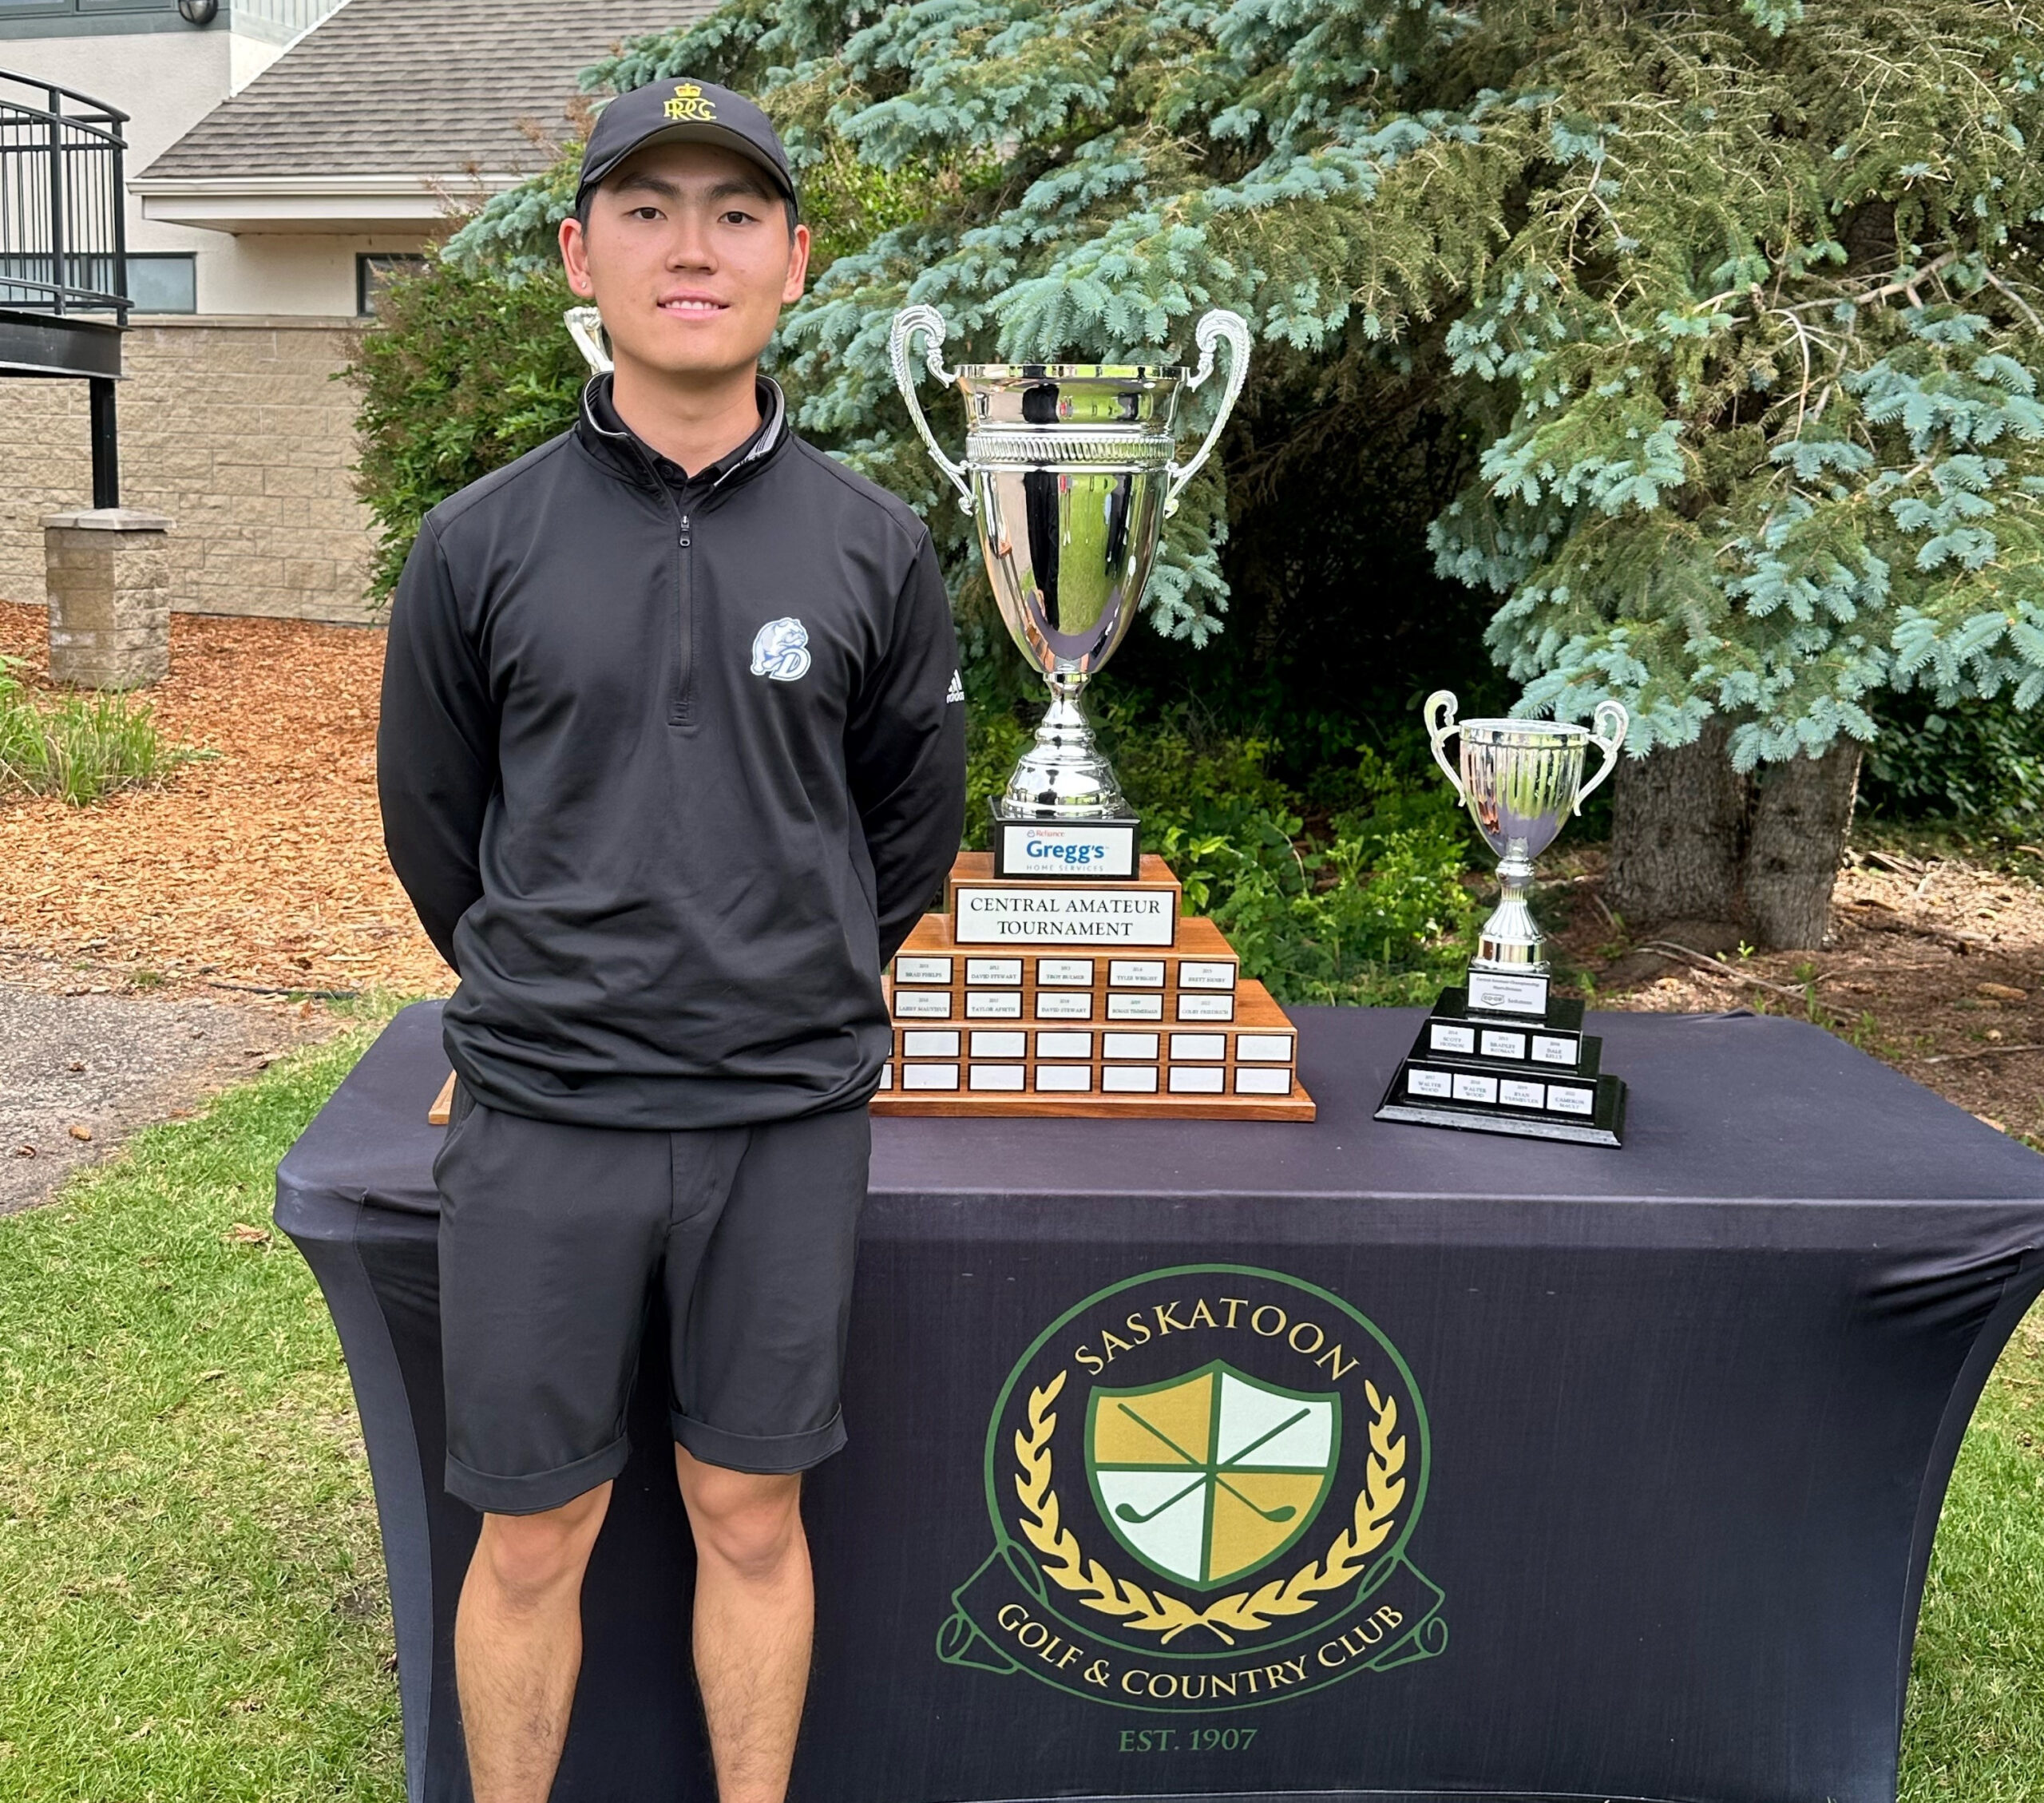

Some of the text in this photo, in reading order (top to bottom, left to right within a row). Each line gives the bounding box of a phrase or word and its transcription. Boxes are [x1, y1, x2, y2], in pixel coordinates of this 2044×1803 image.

[1027, 840, 1105, 864] Gregg's
[970, 898, 1161, 914] CENTRAL AMATEUR
[997, 921, 1133, 937] TOURNAMENT
[1074, 1297, 1361, 1381] SASKATOON
[996, 1603, 1404, 1699] GOLF & COUNTRY CLUB
[1118, 1728, 1258, 1753] EST. 1907
